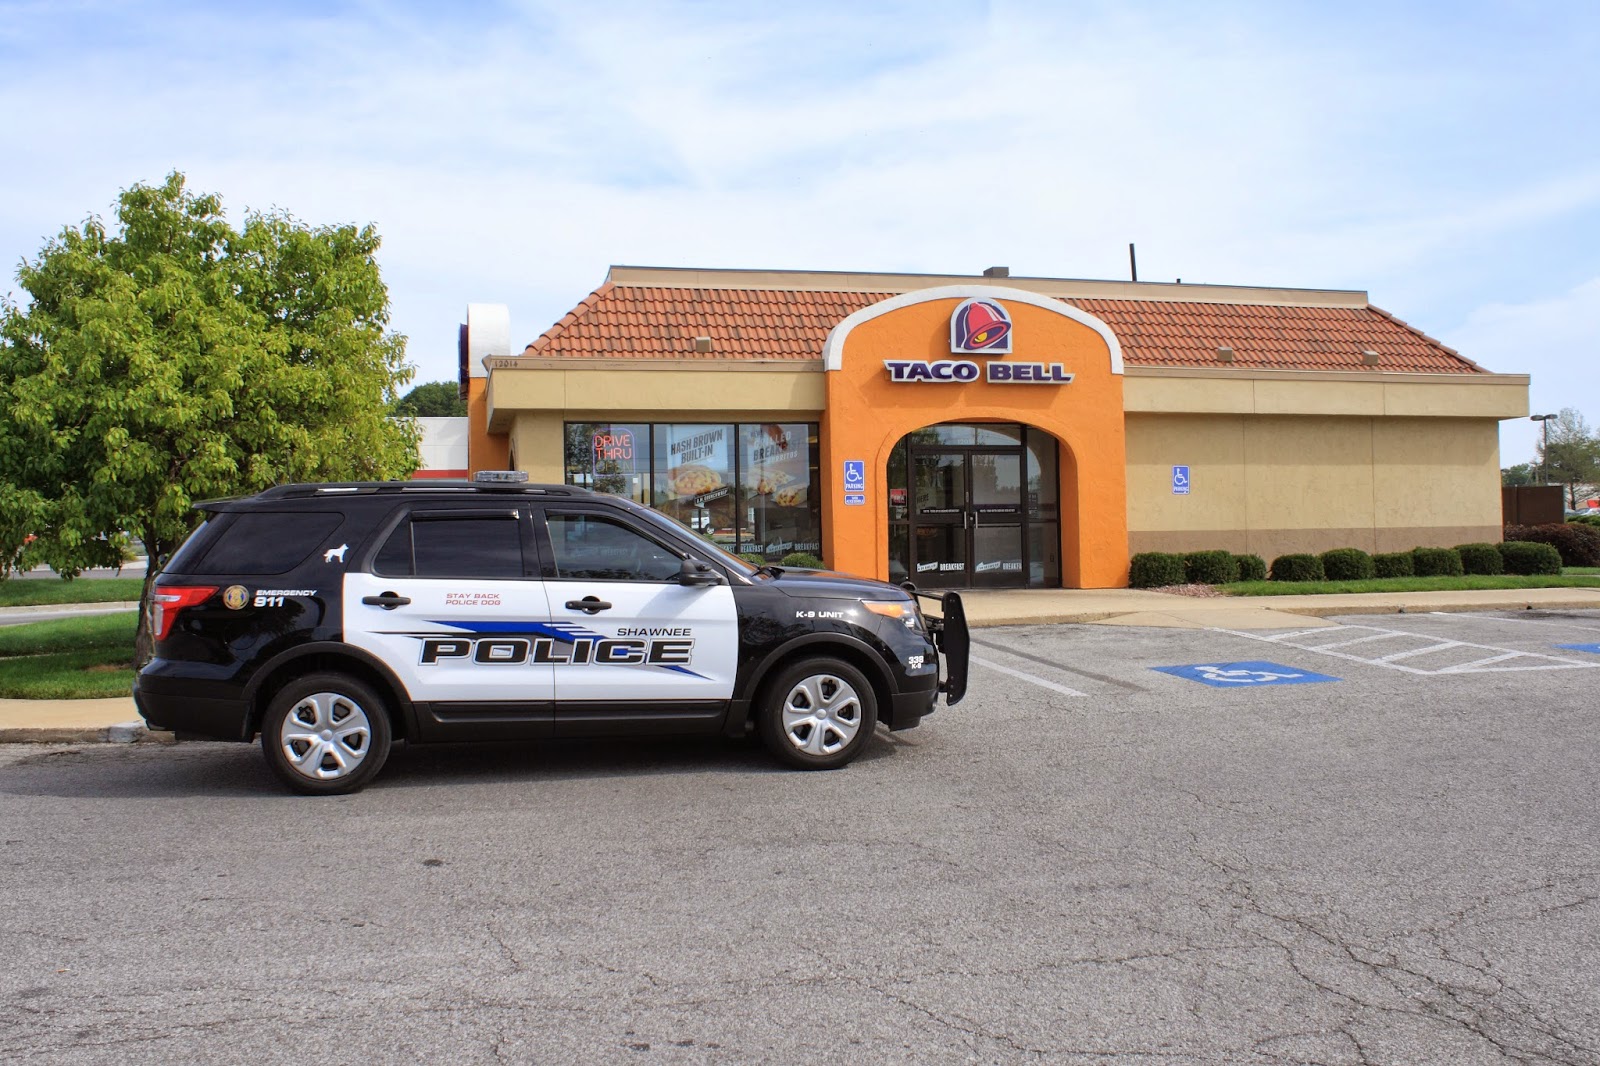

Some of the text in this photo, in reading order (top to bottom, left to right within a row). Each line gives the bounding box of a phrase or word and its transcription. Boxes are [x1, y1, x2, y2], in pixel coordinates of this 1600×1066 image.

[883, 360, 1075, 384] TACO BELL
[594, 434, 631, 447] DRIVE
[671, 429, 723, 455] HASH BROWN
[595, 447, 632, 460] THRU
[681, 444, 713, 464] BUILT-IN
[740, 544, 764, 553] REAKFAST
[939, 562, 965, 571] BREAKFAST
[253, 596, 285, 608] 911
[796, 610, 816, 618] K-9
[616, 628, 692, 636] SHAWNEE
[418, 638, 696, 666] POLICE
